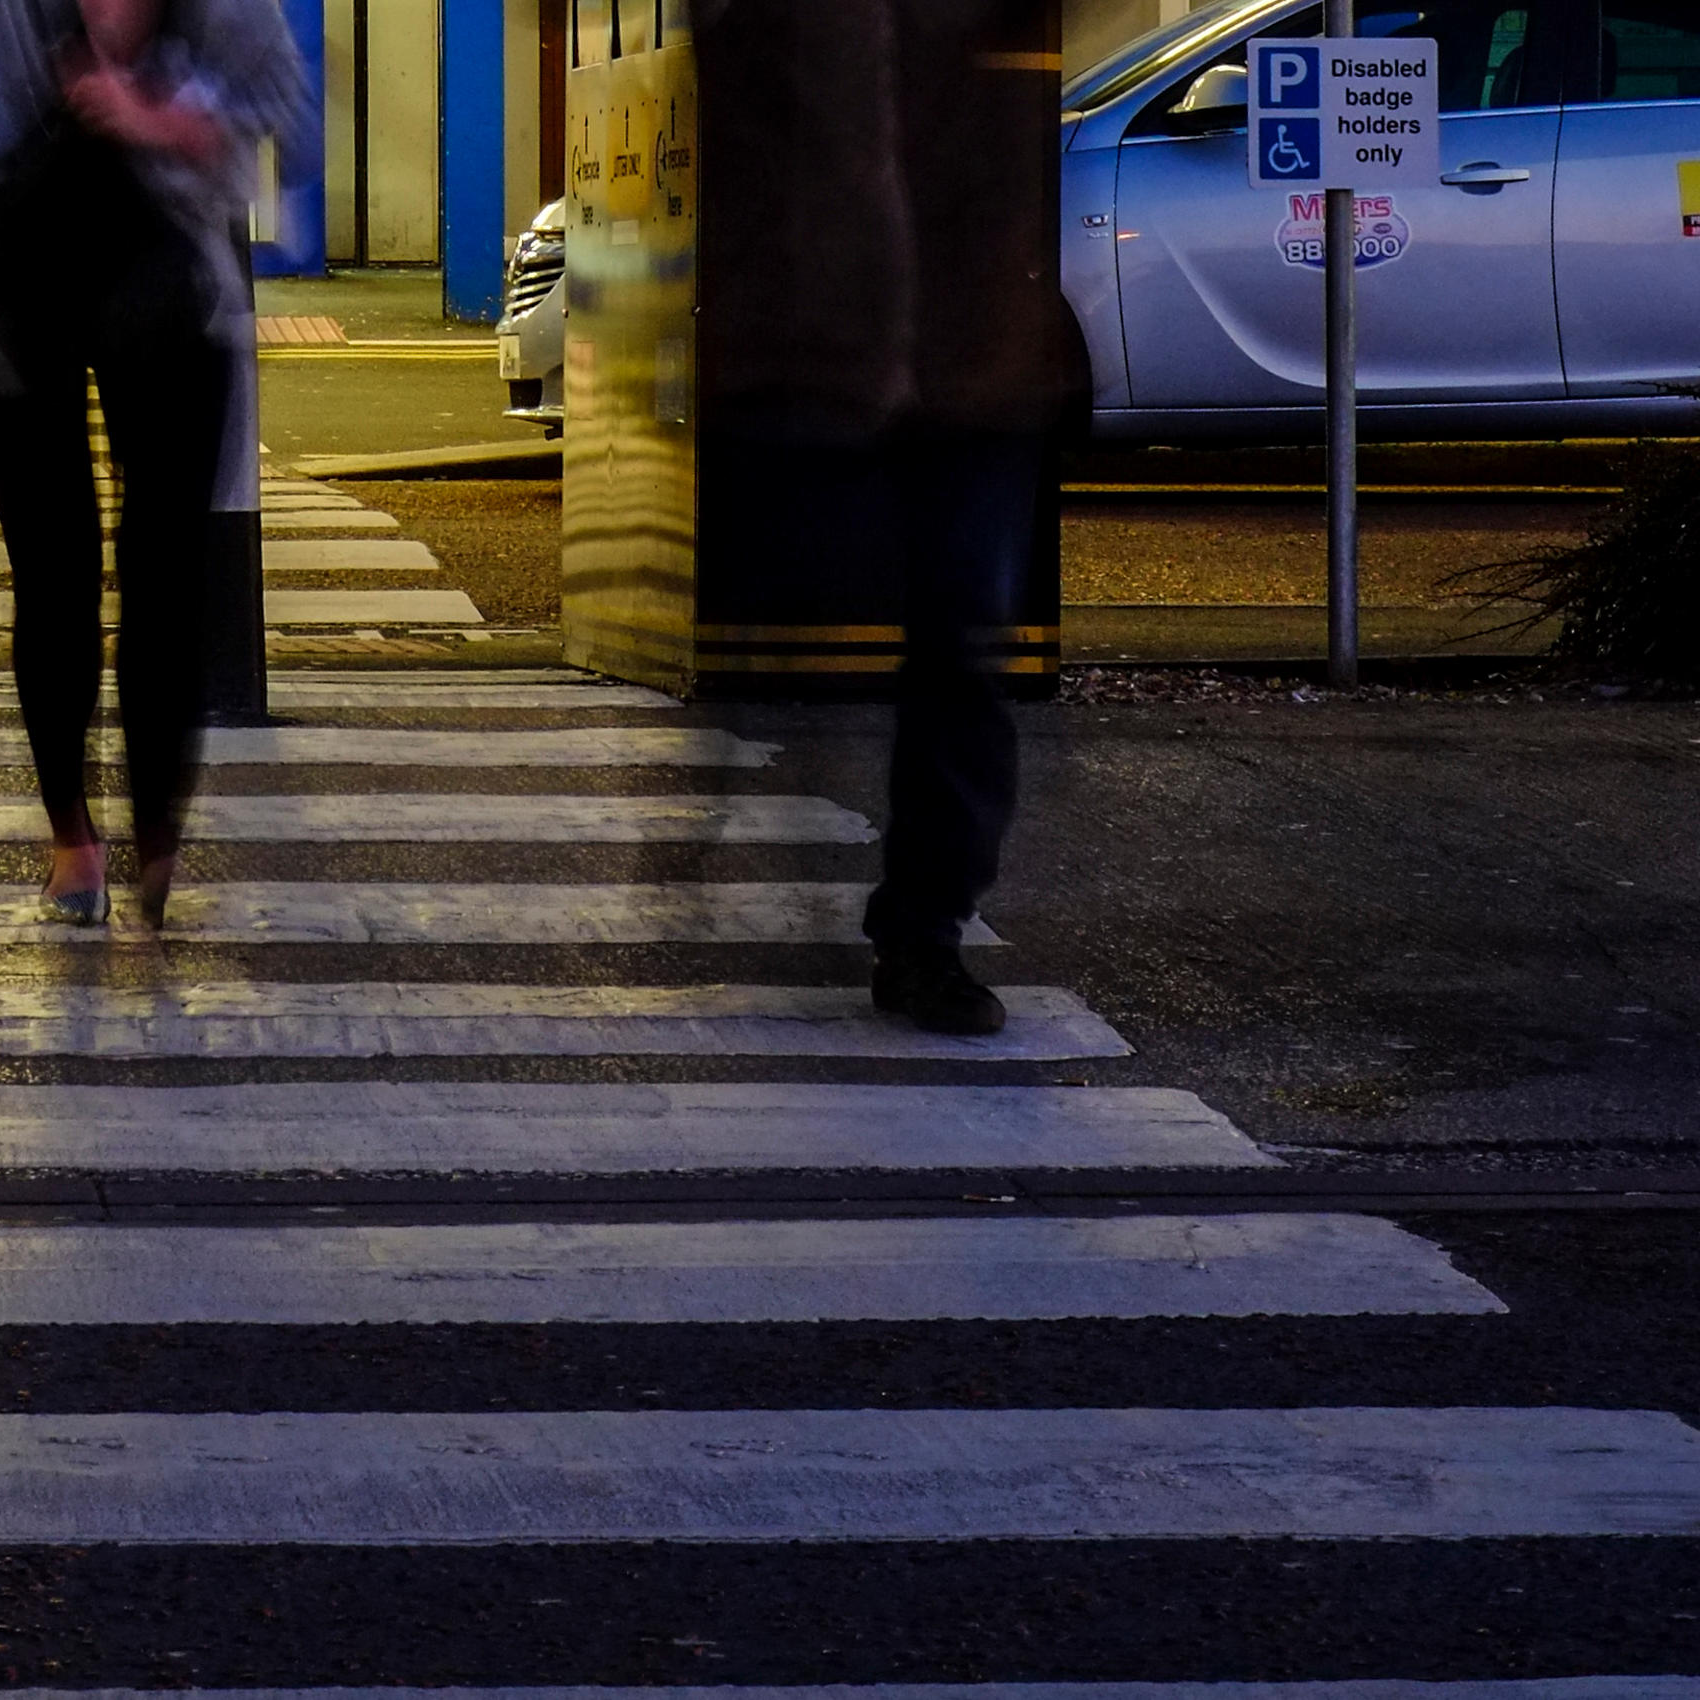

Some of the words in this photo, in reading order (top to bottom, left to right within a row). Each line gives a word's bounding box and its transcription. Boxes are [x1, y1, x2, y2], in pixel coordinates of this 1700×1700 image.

[1270, 53, 1307, 103] P
[1331, 58, 1427, 79] Disabled
[1345, 86, 1413, 110] badge
[1337, 115, 1421, 135] holders
[1355, 144, 1403, 167] only
